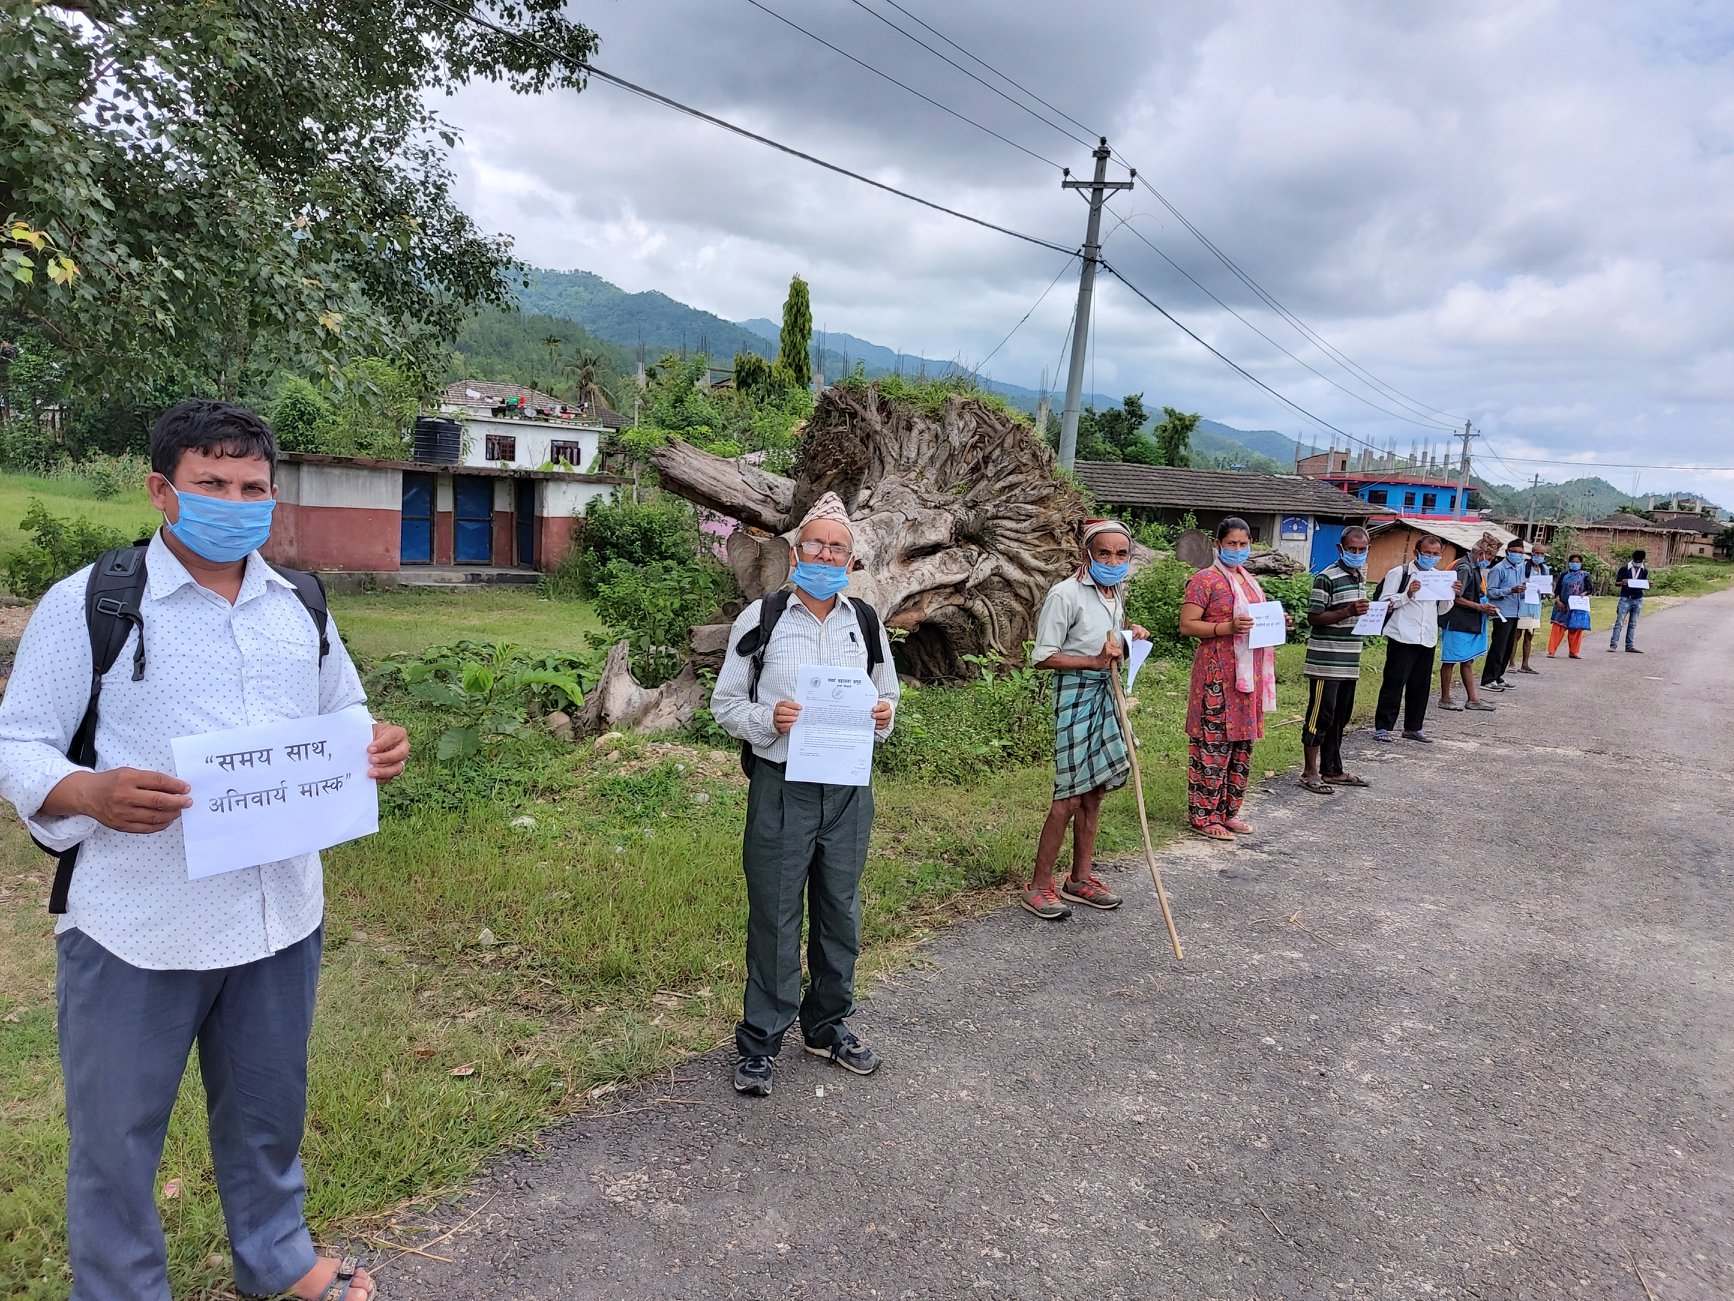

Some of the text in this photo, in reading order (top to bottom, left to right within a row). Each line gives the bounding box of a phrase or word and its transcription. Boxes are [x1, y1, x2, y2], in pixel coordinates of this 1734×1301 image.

[205, 740, 332, 773] “समय साथ,
[208, 772, 352, 814] अनिवार्य मास्क”
